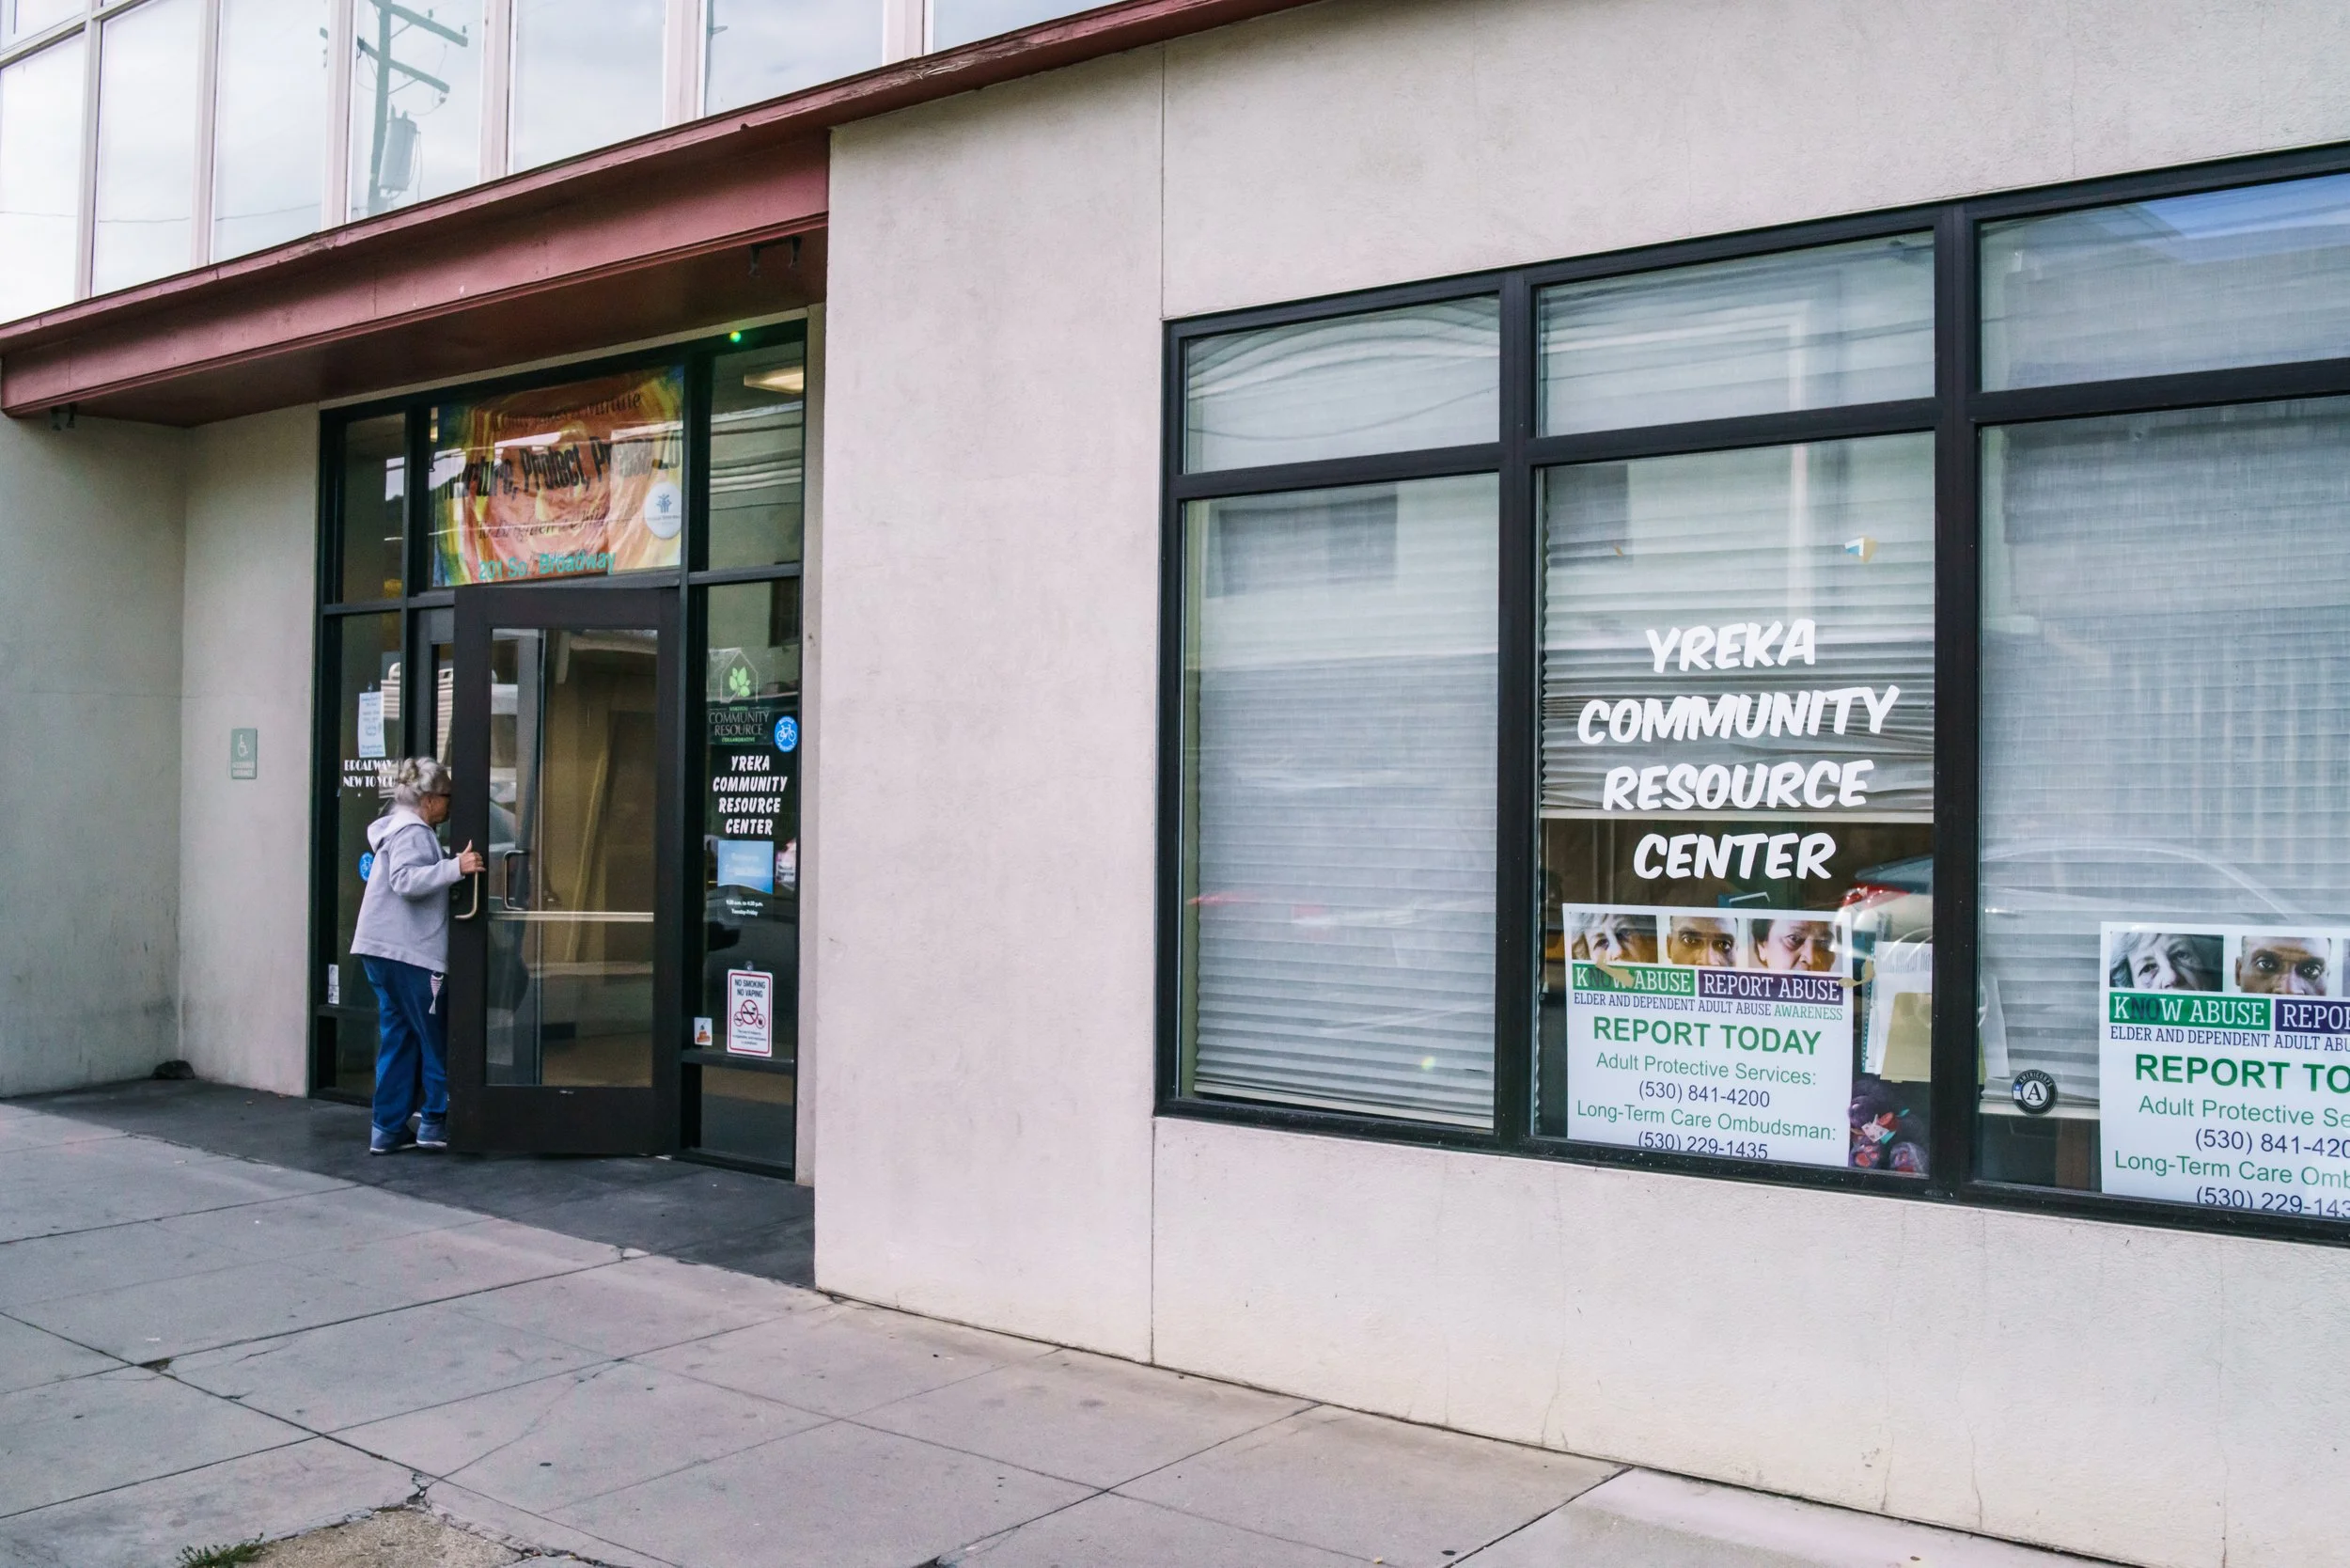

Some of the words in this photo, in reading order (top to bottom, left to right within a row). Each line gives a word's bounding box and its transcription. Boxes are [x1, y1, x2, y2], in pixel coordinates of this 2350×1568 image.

[478, 559, 503, 580] 201
[508, 556, 531, 578] So.
[539, 550, 617, 576] Broadway
[1645, 619, 1816, 673] YREKA
[709, 711, 770, 723] COMMUNITY
[1577, 684, 1900, 745] COMMUNITY
[714, 724, 763, 736] RESOURCE
[344, 759, 392, 771] BROADWAY
[730, 755, 770, 772] YREKA
[343, 776, 363, 788] NEW
[365, 776, 376, 788] TO
[377, 775, 395, 788] YOU
[713, 776, 788, 792] COMMUNITY
[1603, 760, 1874, 811] RESOURCE
[718, 797, 781, 813] RESOURCE
[725, 819, 774, 836] CENTER
[1633, 832, 1837, 880] CENTER
[734, 979, 742, 987] NO
[743, 980, 765, 989] SMOKING
[745, 989, 763, 998] VAPING
[1634, 969, 1691, 993] ABUSE
[1703, 973, 1774, 998] REPORT
[1778, 978, 1841, 1001] ABUSE
[1574, 993, 1606, 1006] ELDER
[1608, 994, 1631, 1008] AND
[1633, 996, 1696, 1011] DEPENDENT
[1698, 1000, 1733, 1014] ADULT
[1735, 1002, 1772, 1016] ABUSE
[1774, 1005, 1843, 1021] AWARENESS
[2113, 996, 2183, 1023] KNOW
[2188, 999, 2265, 1027] ABUSE
[1593, 1016, 1711, 1048] REPORT
[1719, 1024, 1822, 1057] TODAY
[2110, 1026, 2153, 1042] ELDER
[2155, 1027, 2185, 1043] AND
[2187, 1029, 2270, 1048] DEPENDENT
[2275, 1034, 2321, 1051] ADULT
[1596, 1052, 1638, 1072] Adult
[1644, 1055, 1730, 1078] Protective
[1735, 1062, 1817, 1086] Services:
[2135, 1053, 2291, 1090] REPORT
[2302, 1063, 2350, 1094] TO
[1638, 1080, 1683, 1104] (530)
[1688, 1085, 1771, 1108] 841-4200
[2026, 1082, 2044, 1101] A
[1577, 1100, 1665, 1124] Long-Term
[1670, 1108, 1712, 1129] Care
[1718, 1113, 1837, 1141] Ombudsman:
[2138, 1094, 2195, 1117] Adult
[2201, 1098, 2314, 1126] Protective
[1638, 1130, 1682, 1152] (530)
[1687, 1136, 1769, 1161] 229-1435
[2195, 1128, 2253, 1155] (530)
[2114, 1150, 2231, 1178] Long-Term
[2238, 1160, 2293, 1184] Care
[2196, 1185, 2254, 1209] (530)
